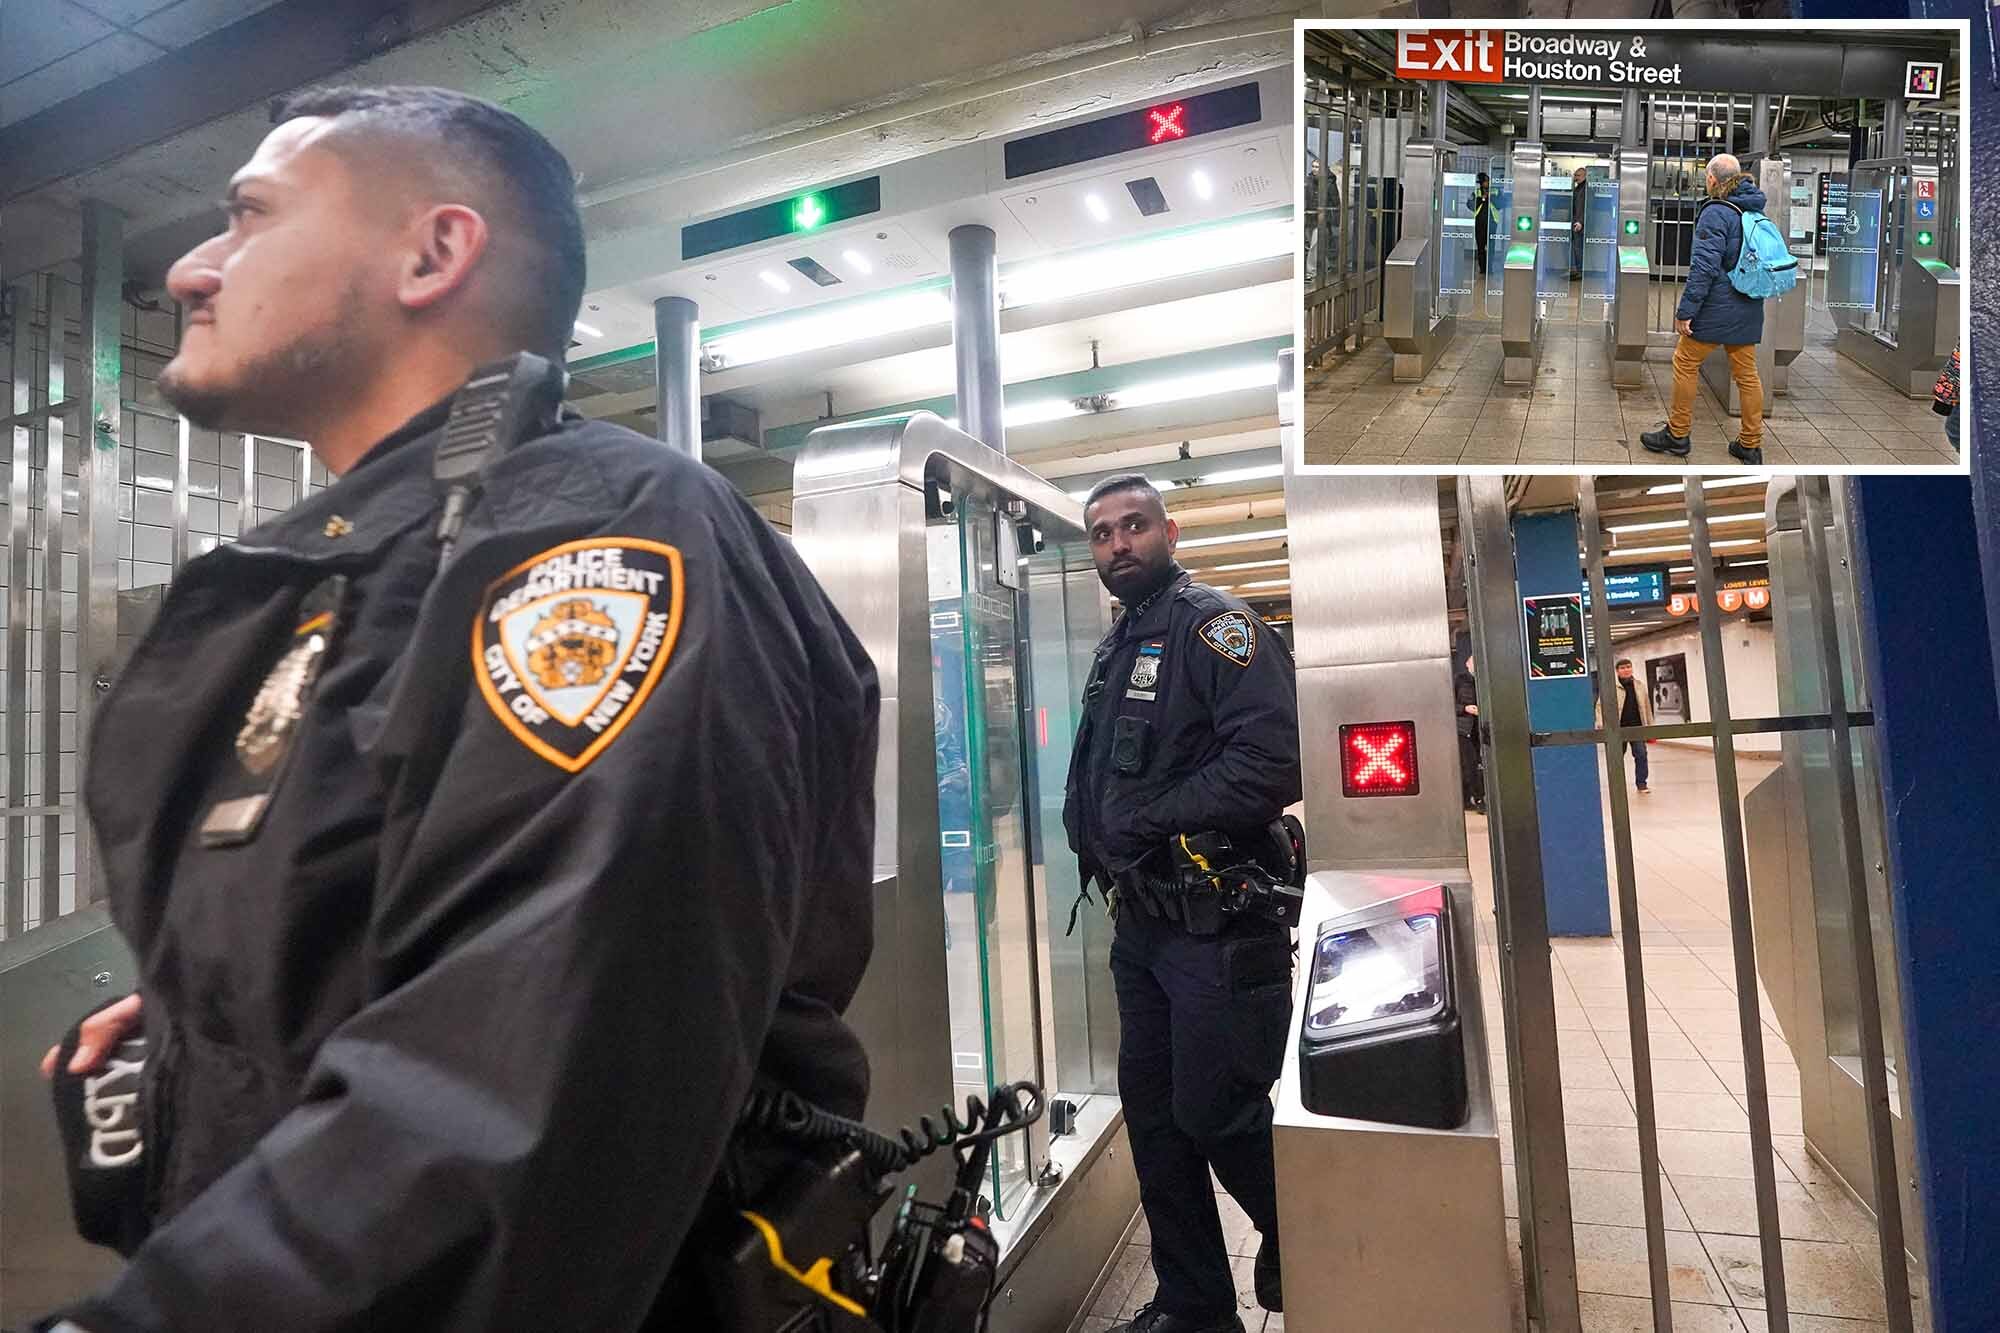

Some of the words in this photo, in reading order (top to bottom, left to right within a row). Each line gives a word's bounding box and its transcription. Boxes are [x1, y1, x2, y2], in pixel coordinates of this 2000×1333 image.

[1398, 29, 1494, 73] Exit
[1504, 31, 1622, 60] Broadway
[1629, 36, 1647, 58] &
[1504, 57, 1602, 81] Houston
[1608, 61, 1682, 84] Street
[527, 548, 624, 584] POLICE
[1748, 579, 1769, 587] LEVEL
[1672, 597, 1684, 611] B
[1723, 592, 1735, 607] F
[1748, 591, 1764, 604] M
[484, 644, 521, 693] CITY
[510, 694, 551, 725] OF
[583, 679, 635, 733] NEW
[626, 611, 668, 673] YORK
